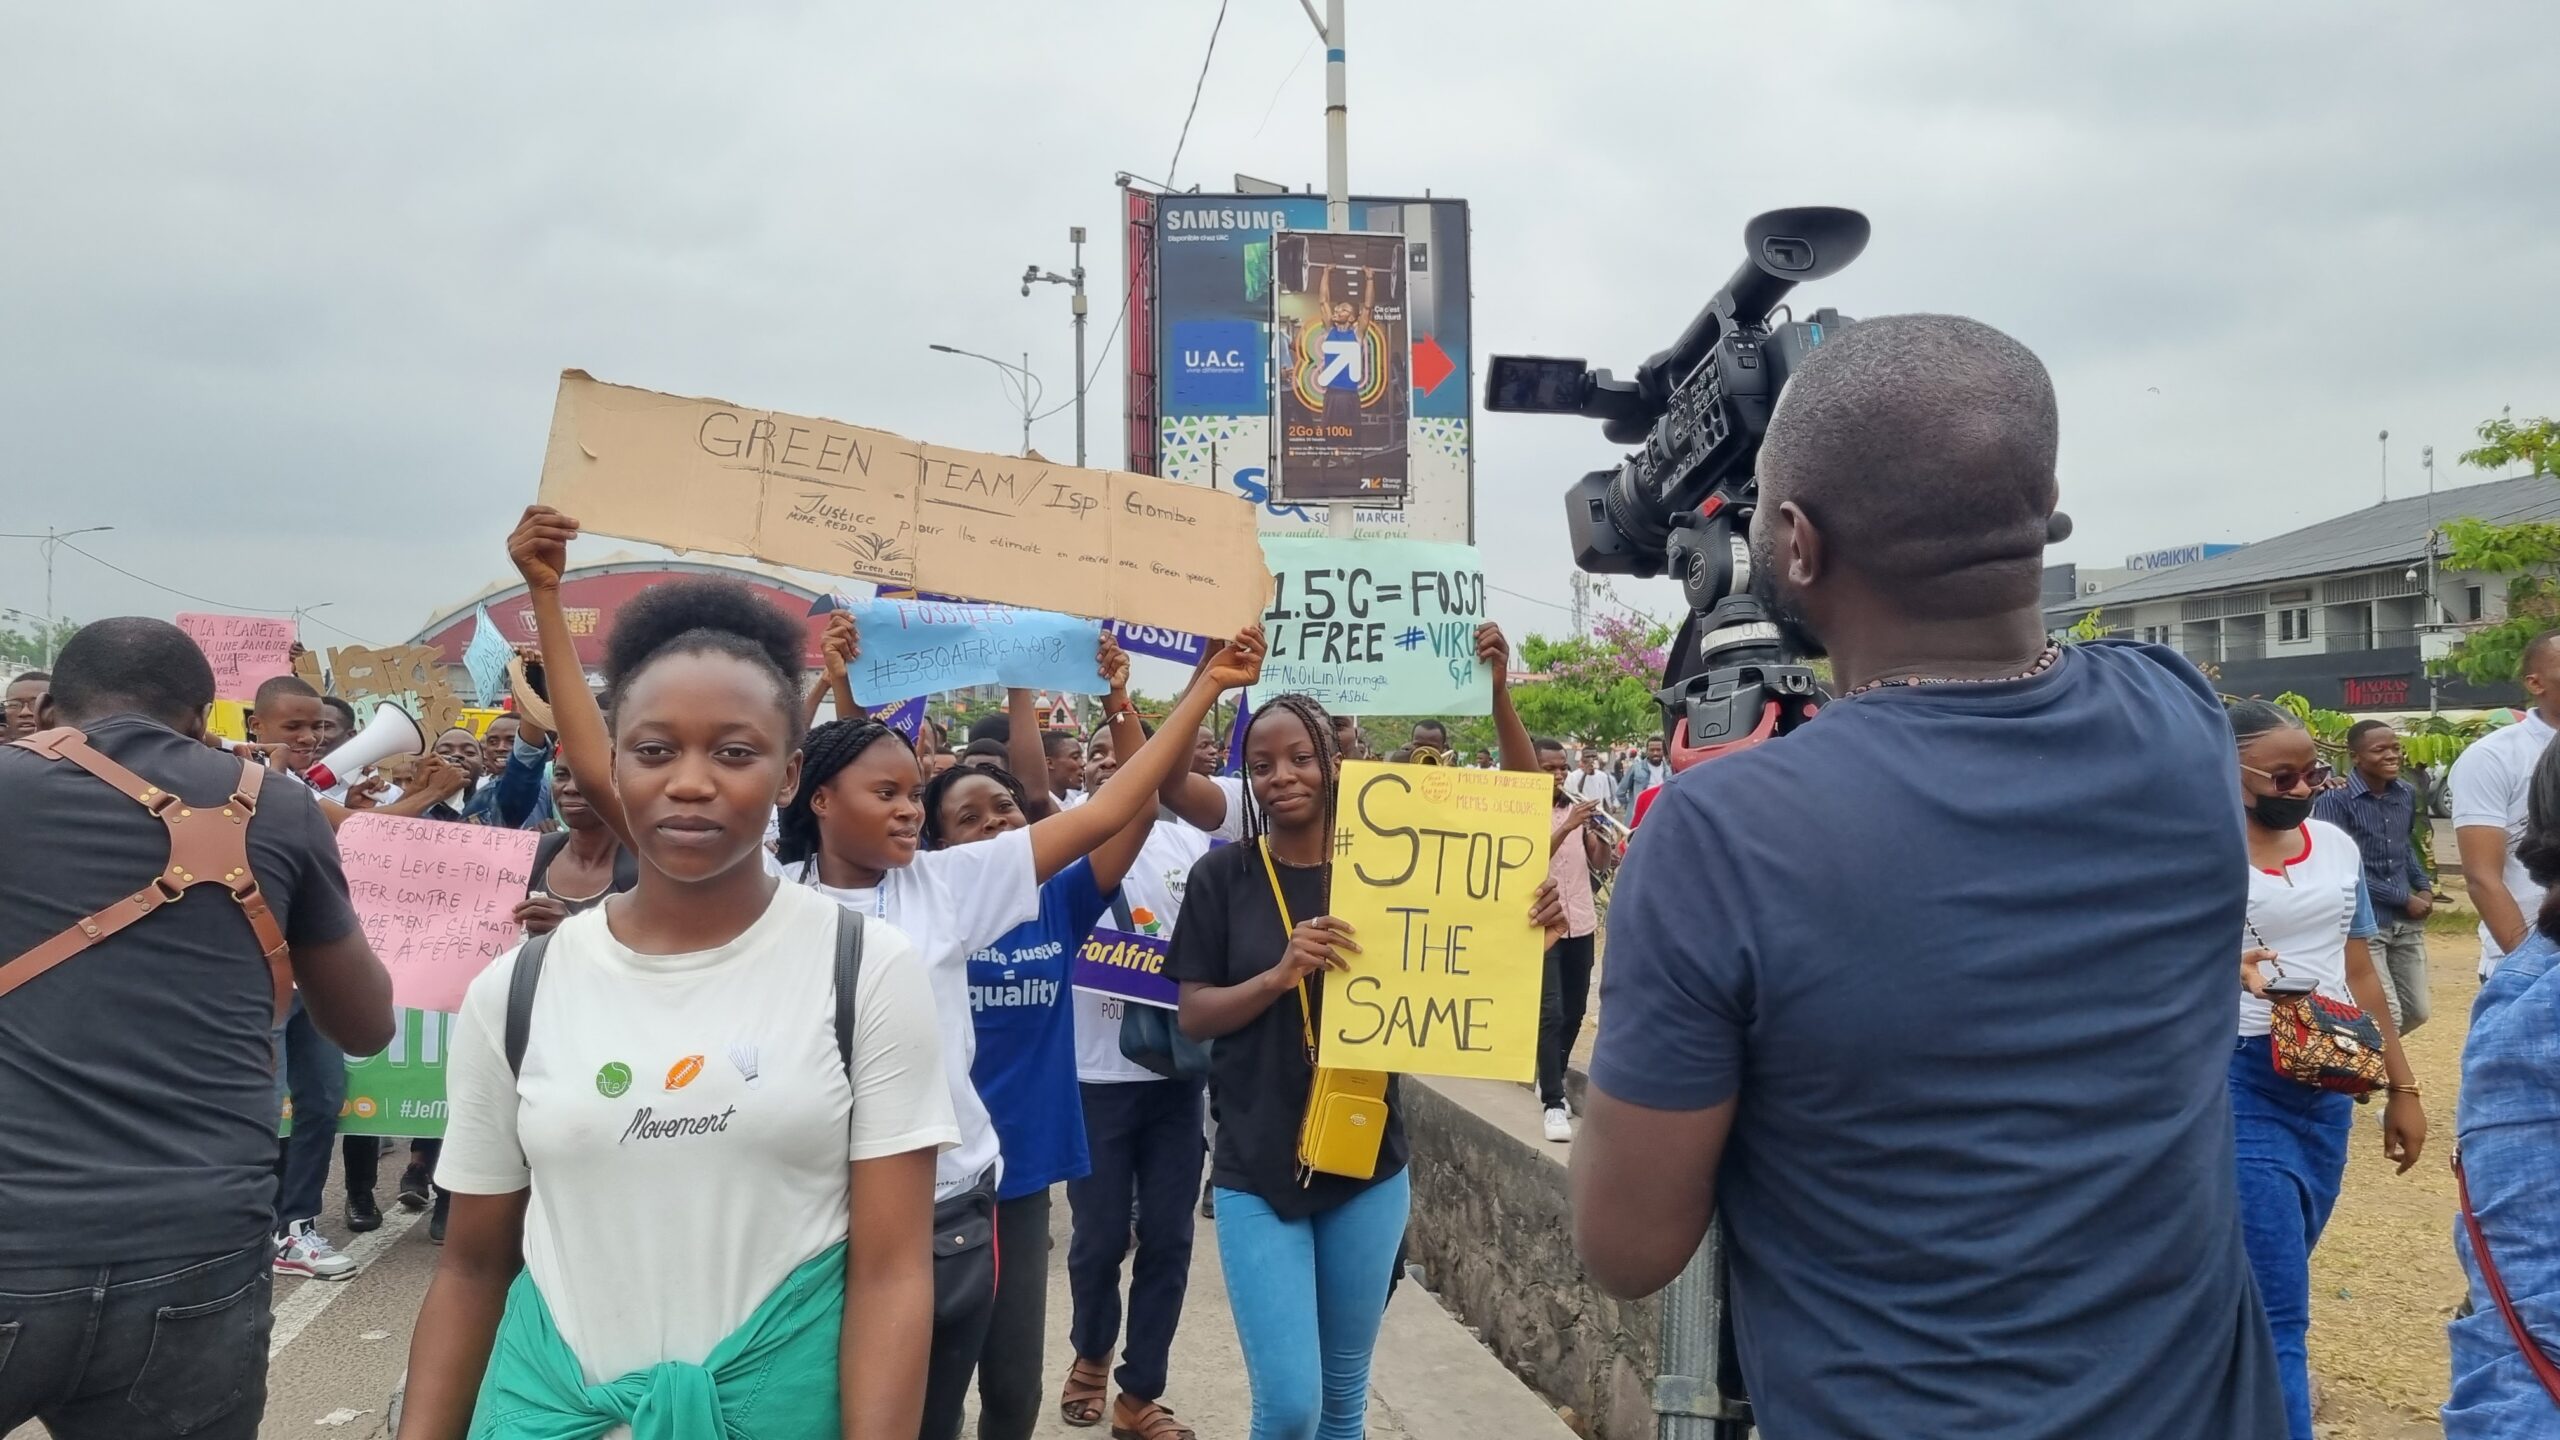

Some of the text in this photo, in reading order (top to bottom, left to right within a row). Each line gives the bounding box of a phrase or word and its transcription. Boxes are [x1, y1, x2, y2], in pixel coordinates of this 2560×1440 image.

[1167, 209, 1286, 230] SAMSUNG
[1185, 350, 1245, 367] U.A.C.
[1289, 426, 1313, 437] 2Go
[1326, 426, 1352, 437] 100u
[700, 412, 873, 477] GREEN
[1126, 491, 1197, 526] Gombe
[794, 492, 876, 525] Justice
[1151, 560, 1181, 577] Green
[853, 560, 884, 575] Green
[1299, 621, 1386, 665] FREE
[1386, 906, 1473, 975] THE
[968, 979, 1060, 1012] quality
[1101, 1002, 1123, 1020] POU
[1339, 976, 1494, 1051] SAME
[620, 1104, 737, 1143] Movement
